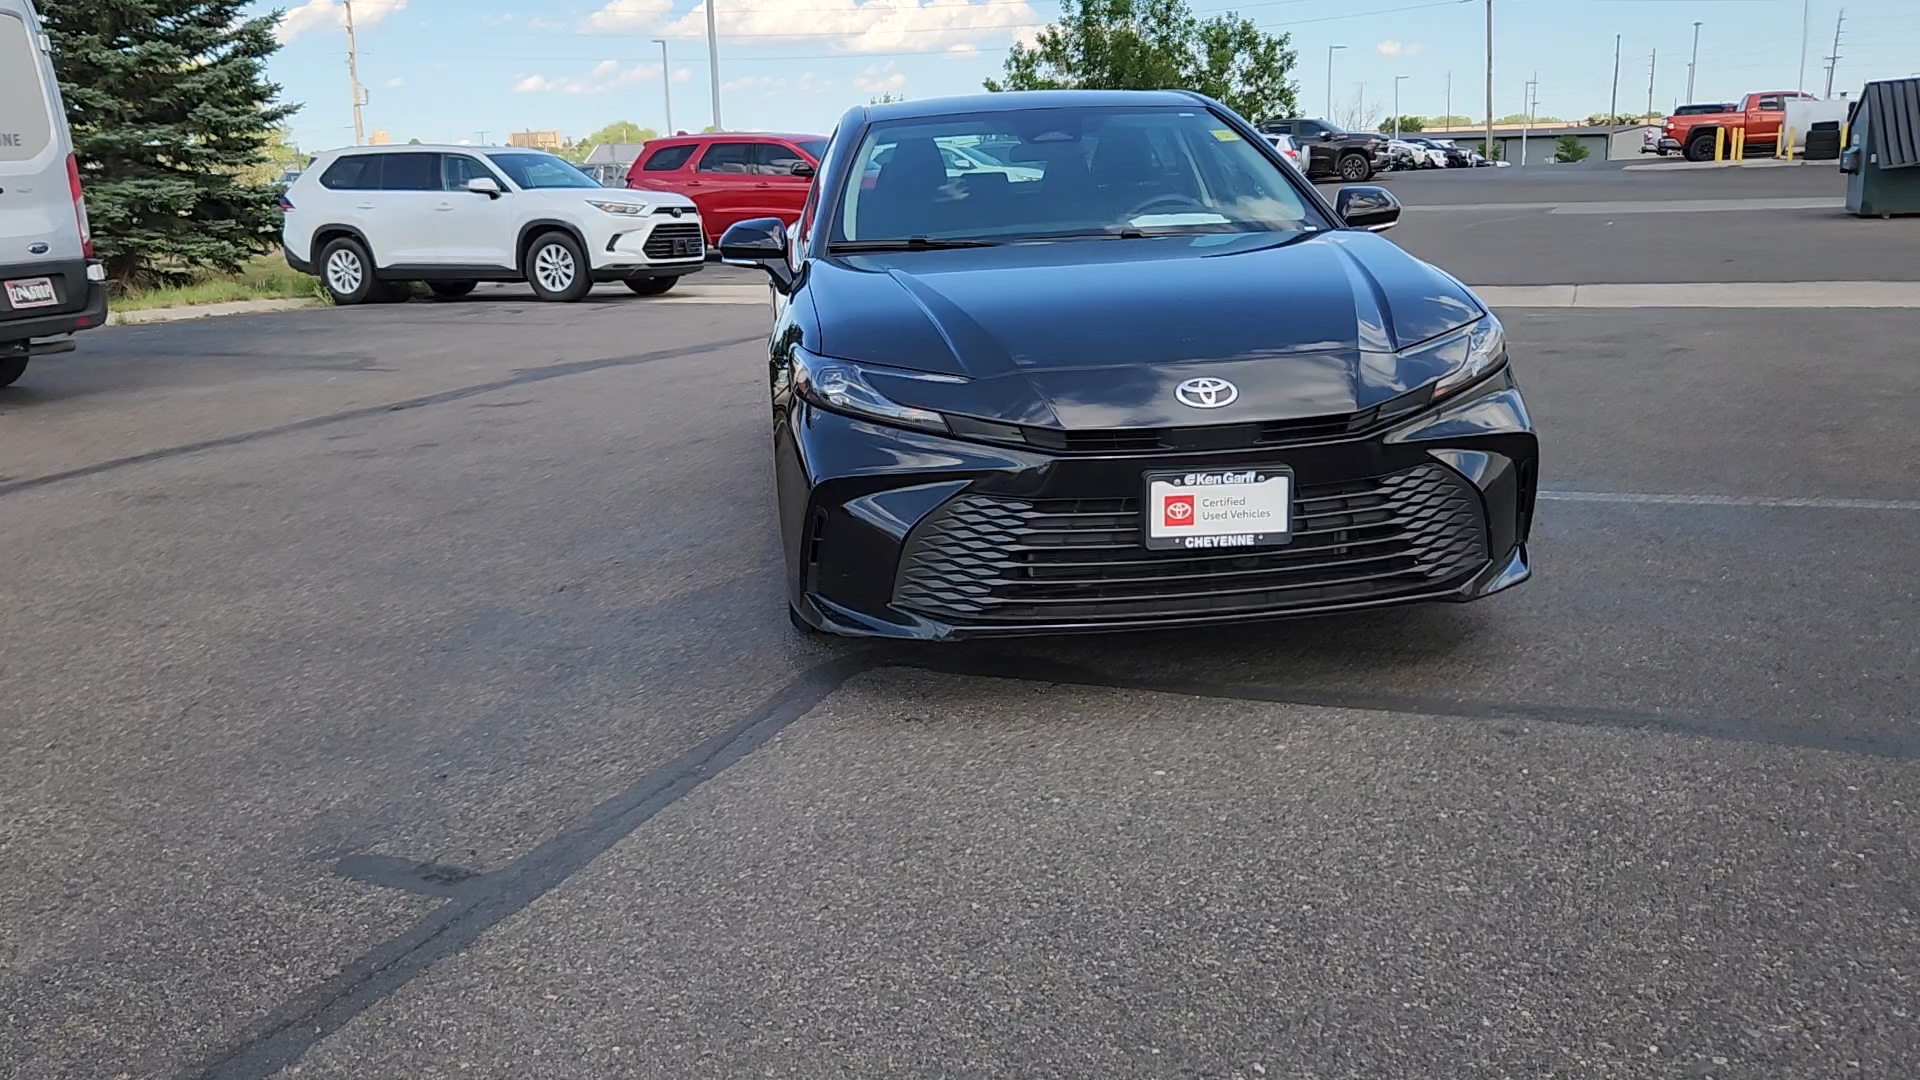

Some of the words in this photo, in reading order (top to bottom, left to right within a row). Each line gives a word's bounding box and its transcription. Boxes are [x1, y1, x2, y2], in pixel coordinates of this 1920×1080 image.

[0, 133, 21, 147] NE
[1196, 473, 1221, 485] Ken
[1222, 471, 1256, 484] Garff
[1202, 497, 1246, 508] Certified
[1202, 511, 1228, 520] Used
[1230, 509, 1271, 519] Vehicles
[1184, 535, 1255, 548] CHEYENNE
